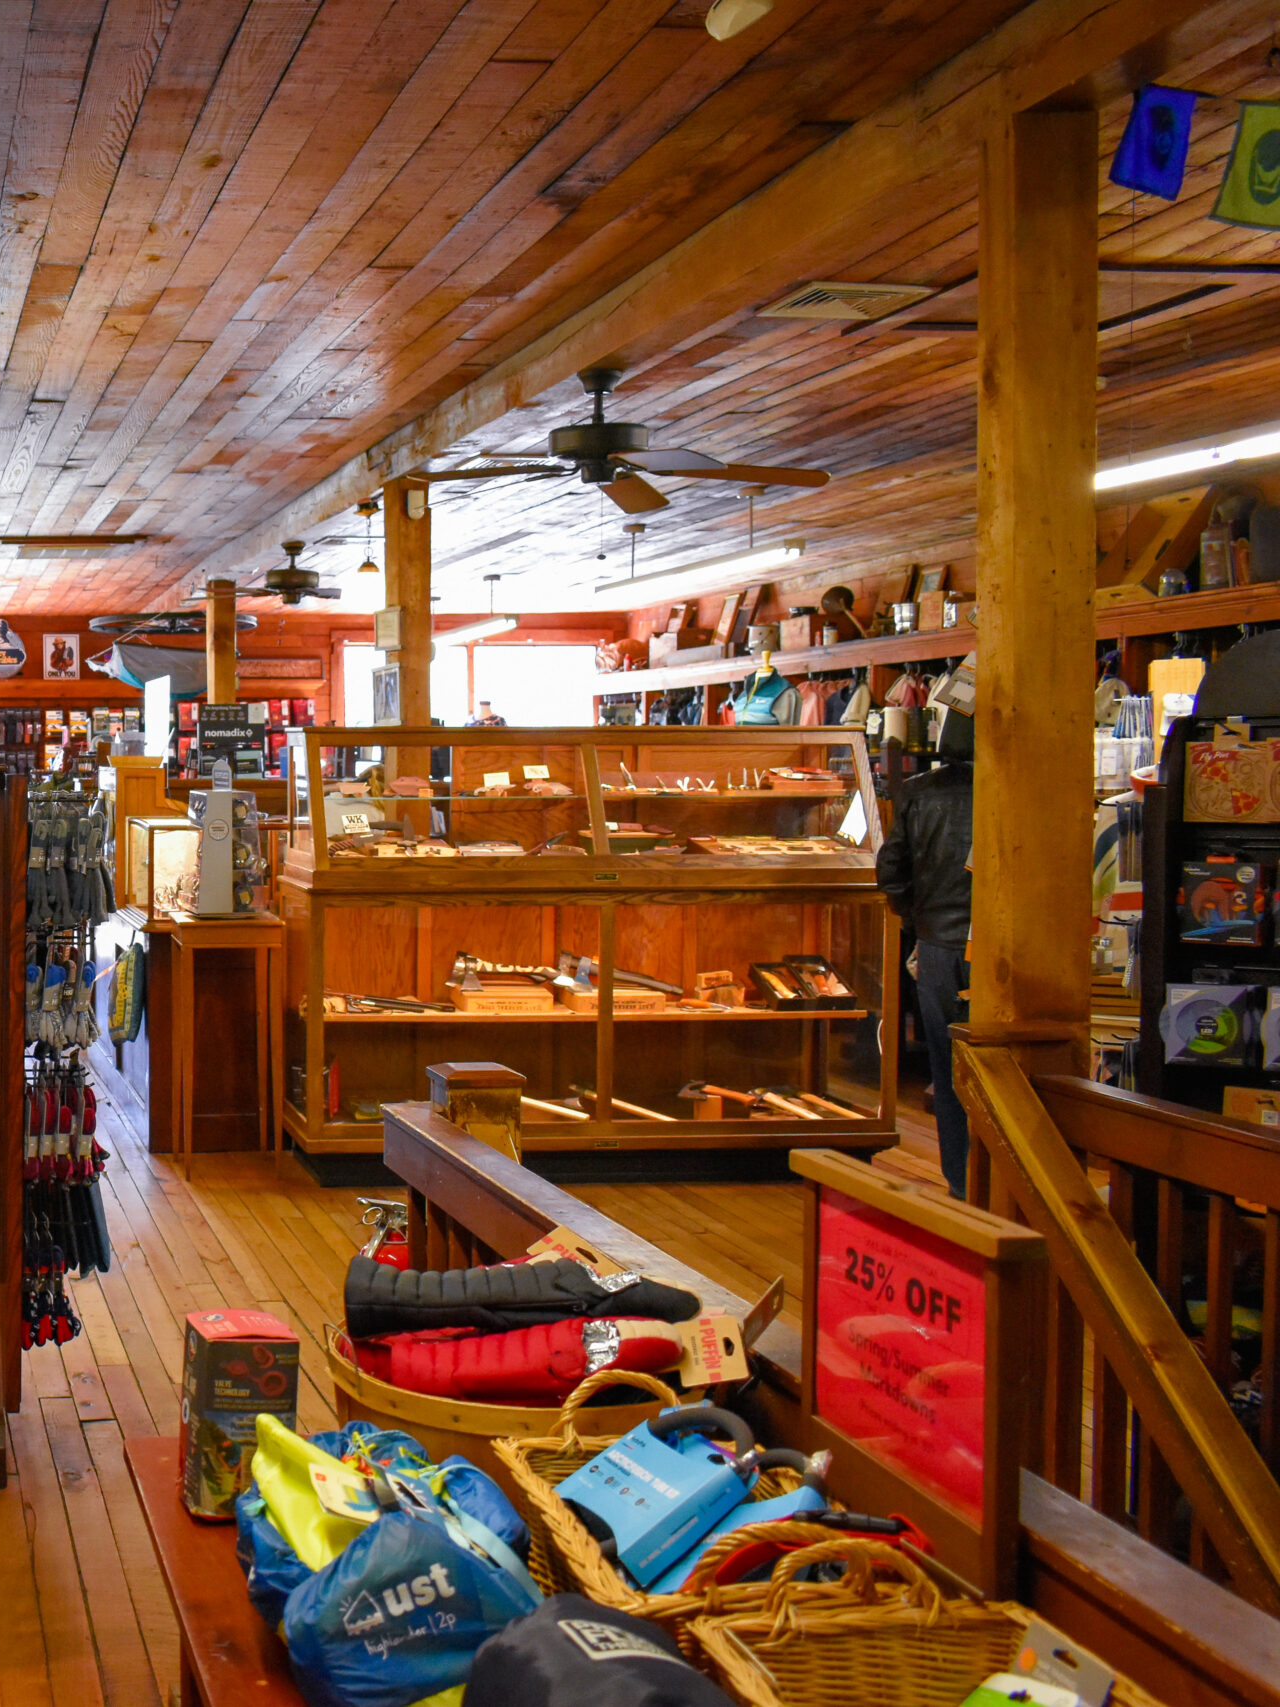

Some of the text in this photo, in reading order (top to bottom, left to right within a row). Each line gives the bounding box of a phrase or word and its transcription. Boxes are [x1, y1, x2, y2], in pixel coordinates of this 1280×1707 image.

[204, 728, 246, 737] nomadix
[845, 1247, 895, 1301] 25%
[906, 1277, 961, 1334] OFF
[382, 1562, 456, 1617] ust
